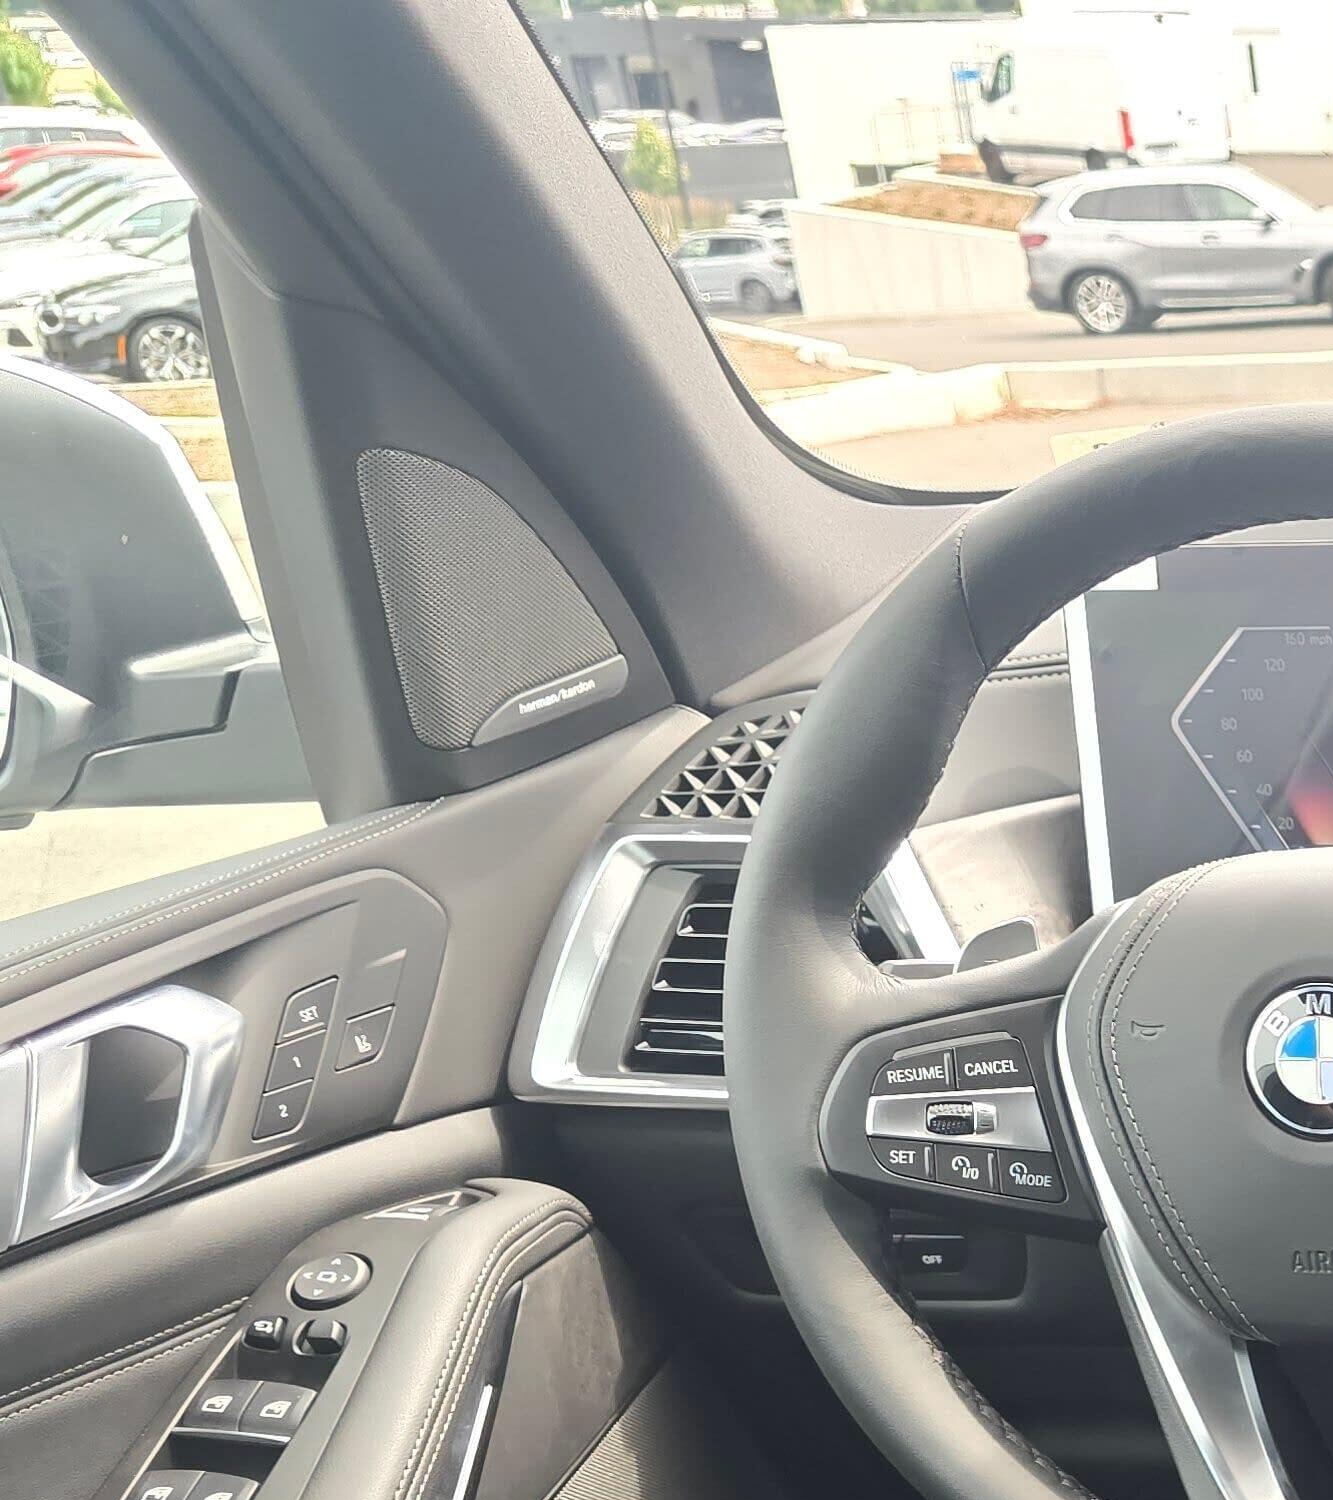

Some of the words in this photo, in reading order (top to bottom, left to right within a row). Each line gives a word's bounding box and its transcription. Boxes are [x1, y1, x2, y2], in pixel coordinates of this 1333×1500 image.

[1264, 659, 1285, 672] 120
[1241, 688, 1264, 701] 100
[1220, 717, 1237, 731] 80
[1236, 749, 1253, 762] 60
[1256, 783, 1273, 796] 40
[1277, 816, 1294, 830] 20
[298, 1005, 319, 1022] SET
[292, 1056, 302, 1068] 1
[964, 1059, 1018, 1077] CANCEL
[887, 1065, 944, 1084] RESUME
[278, 1104, 288, 1118] 2
[889, 1150, 916, 1164] SET
[1015, 1174, 1052, 1187] MODE
